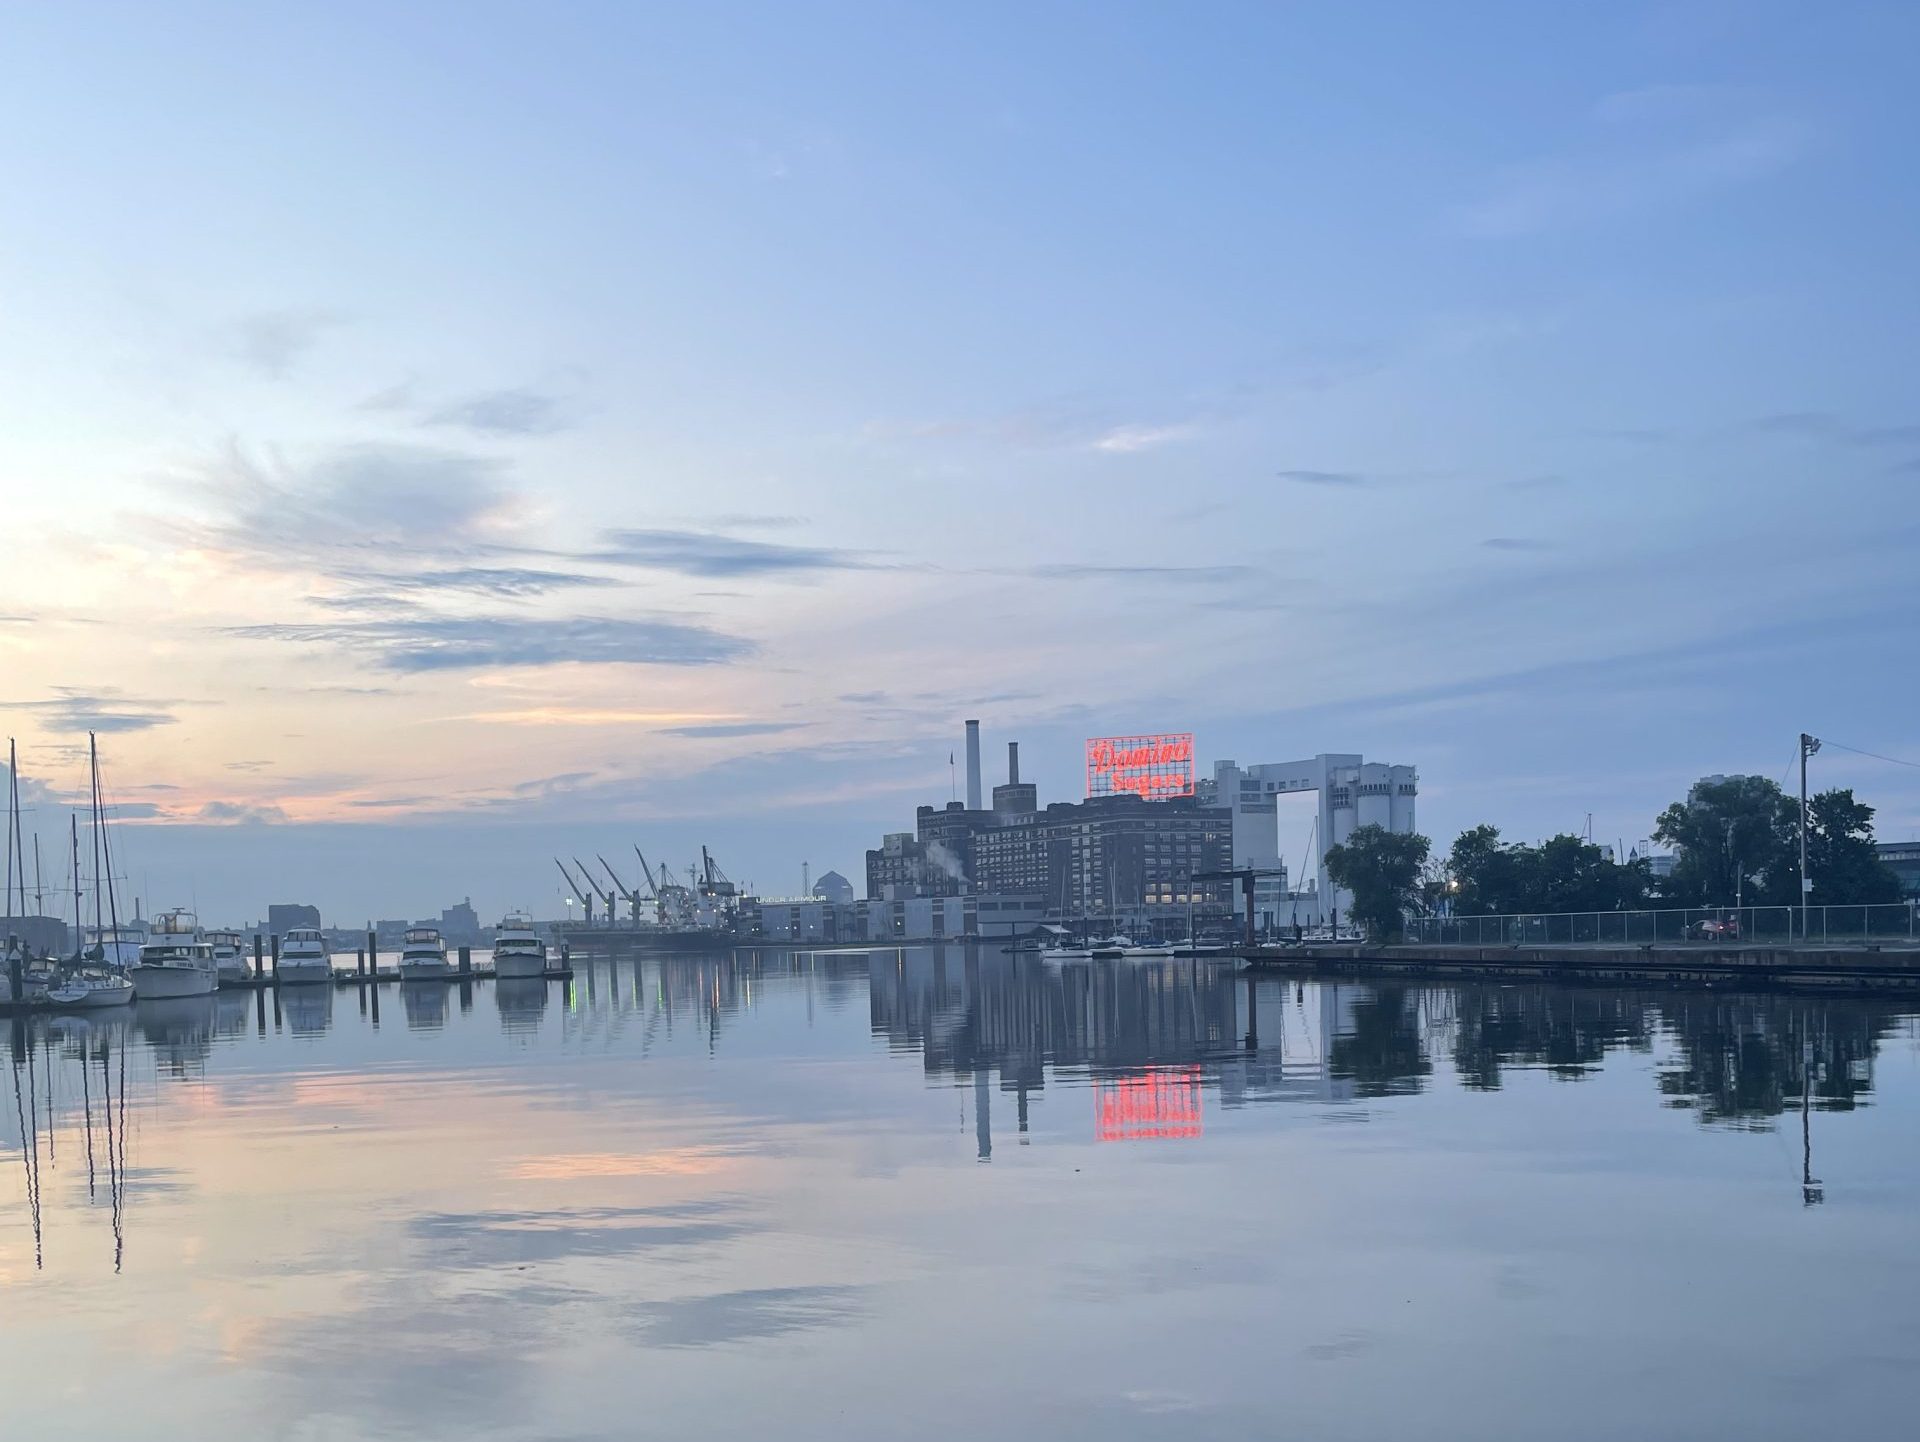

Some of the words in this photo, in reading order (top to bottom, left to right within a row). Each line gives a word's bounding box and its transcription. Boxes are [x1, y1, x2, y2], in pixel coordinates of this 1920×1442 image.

[1092, 736, 1189, 774] Domino
[1112, 772, 1185, 796] Sugars
[755, 896, 786, 904] UNDER
